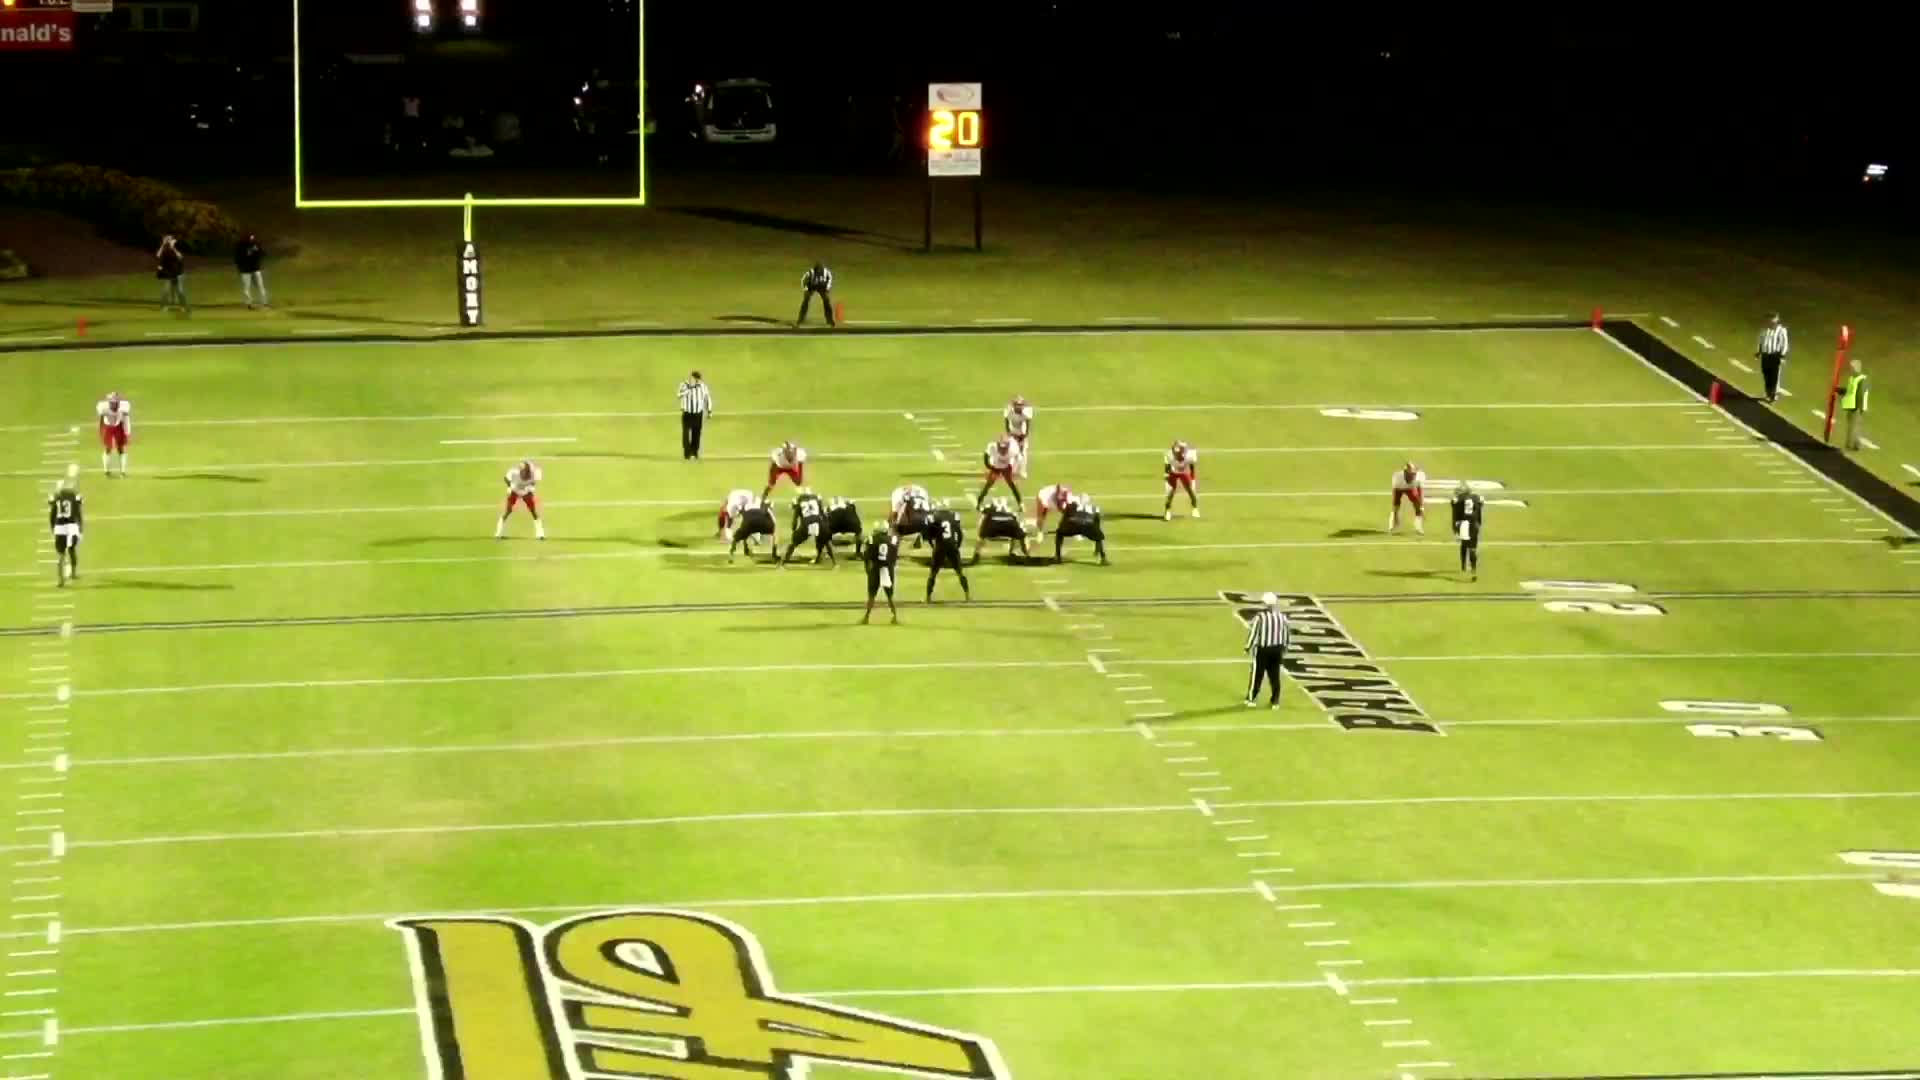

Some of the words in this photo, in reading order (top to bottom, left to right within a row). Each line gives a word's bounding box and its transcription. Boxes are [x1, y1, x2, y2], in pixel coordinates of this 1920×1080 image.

[929, 111, 980, 149] 20
[56, 499, 72, 518] 13
[1464, 498, 1474, 515] 2
[941, 521, 952, 539] 3
[878, 543, 889, 561] 9
[1519, 580, 1668, 615] 20
[1658, 699, 1823, 741] 30
